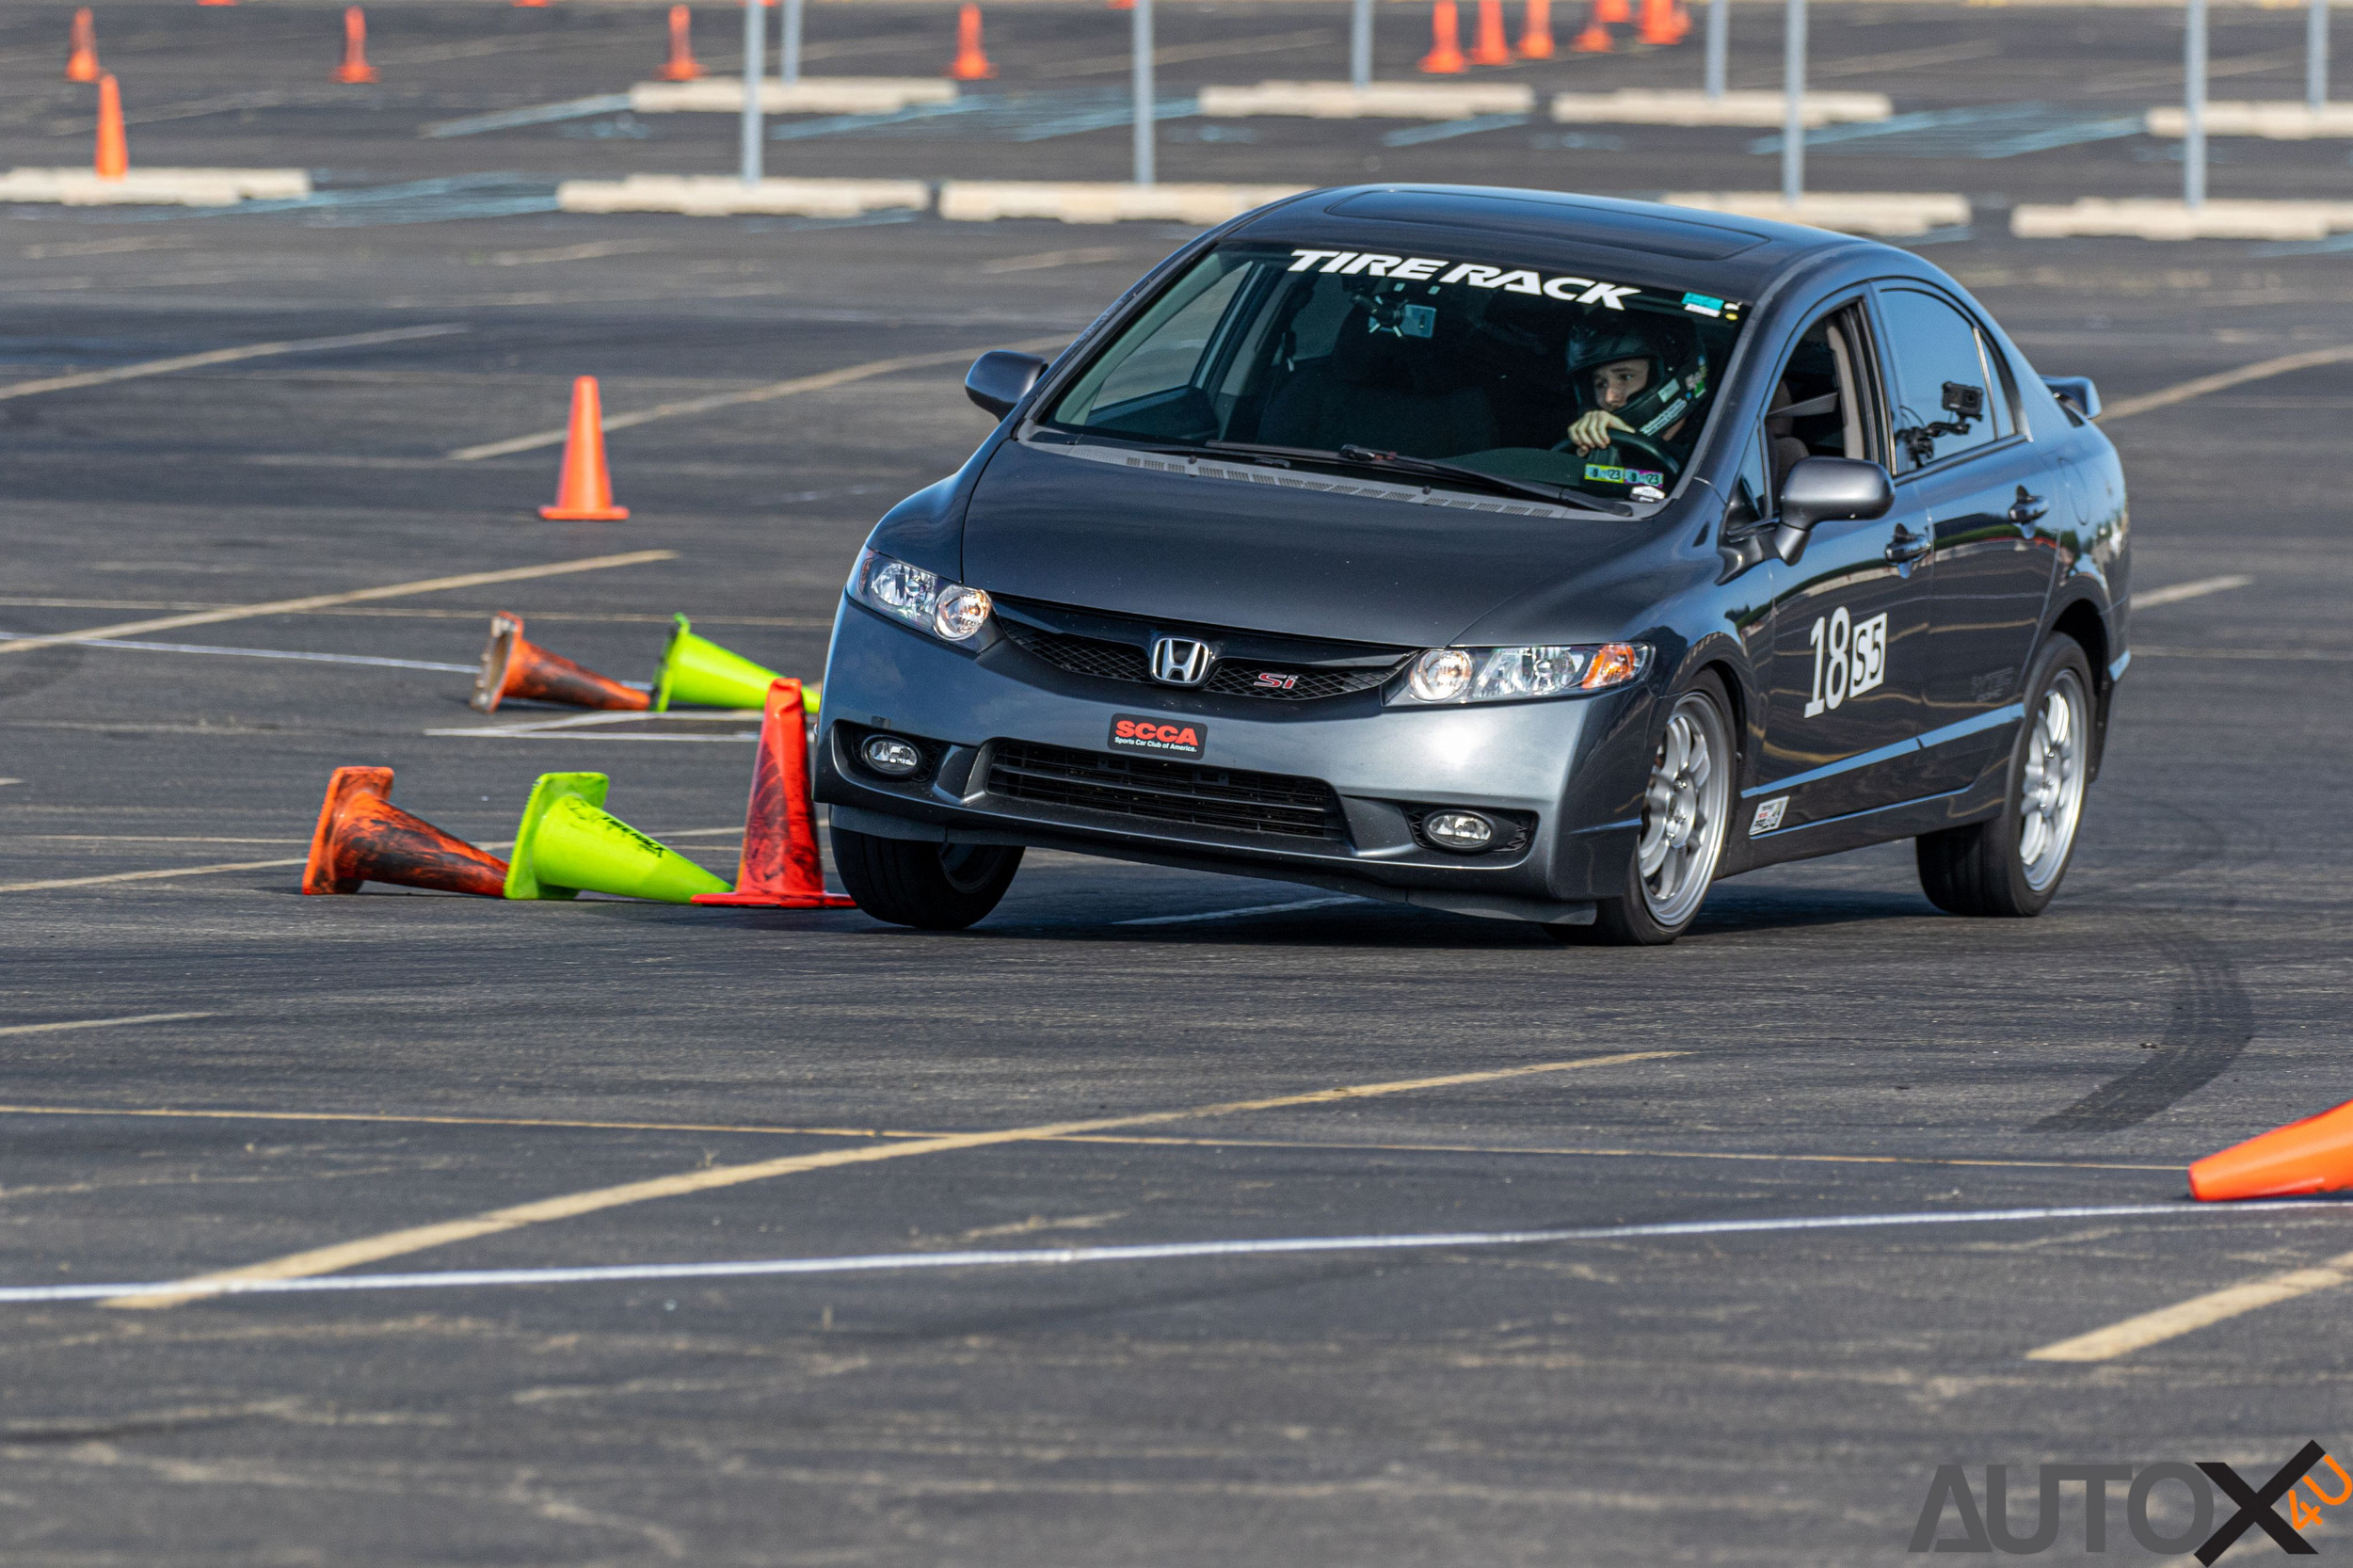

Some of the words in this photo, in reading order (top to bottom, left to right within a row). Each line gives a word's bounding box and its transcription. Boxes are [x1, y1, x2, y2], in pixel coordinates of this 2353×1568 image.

[1288, 248, 1449, 281] TIRE
[1439, 263, 1641, 311] RACK
[1804, 606, 1850, 718] 18
[1254, 672, 1299, 690] Si
[1114, 736, 1135, 745] Sports
[1146, 740, 1162, 748] Club
[1115, 720, 1199, 746] SCCA
